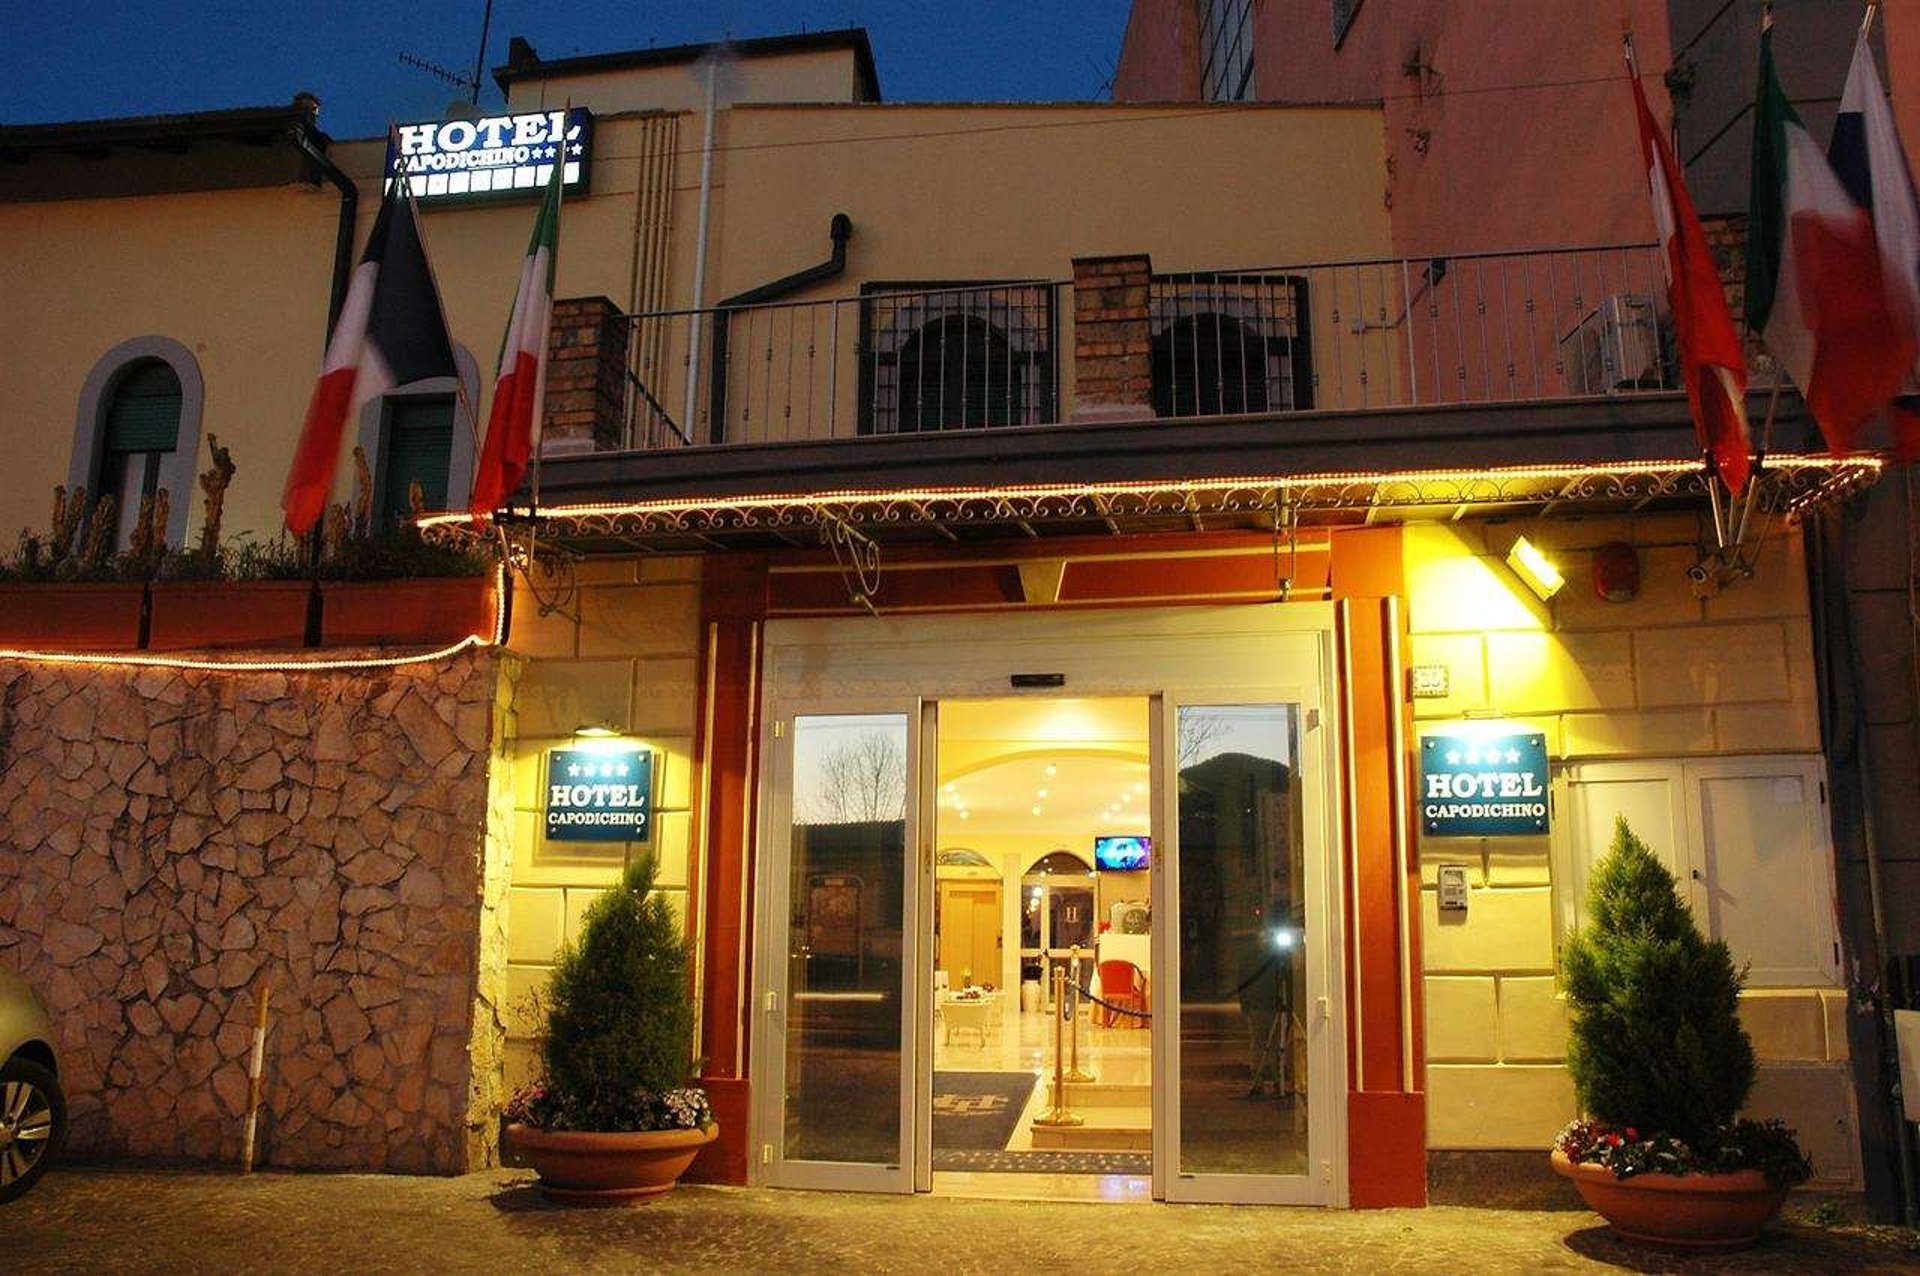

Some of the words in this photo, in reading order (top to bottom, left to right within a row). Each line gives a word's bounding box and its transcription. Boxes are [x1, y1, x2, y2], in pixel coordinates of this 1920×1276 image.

[399, 112, 581, 155] HOTEL
[550, 784, 645, 807] HOTEL
[1426, 772, 1543, 798] HOTEL
[548, 812, 646, 825] CAPODICHINO
[1425, 803, 1546, 818] CAPODICHINO
